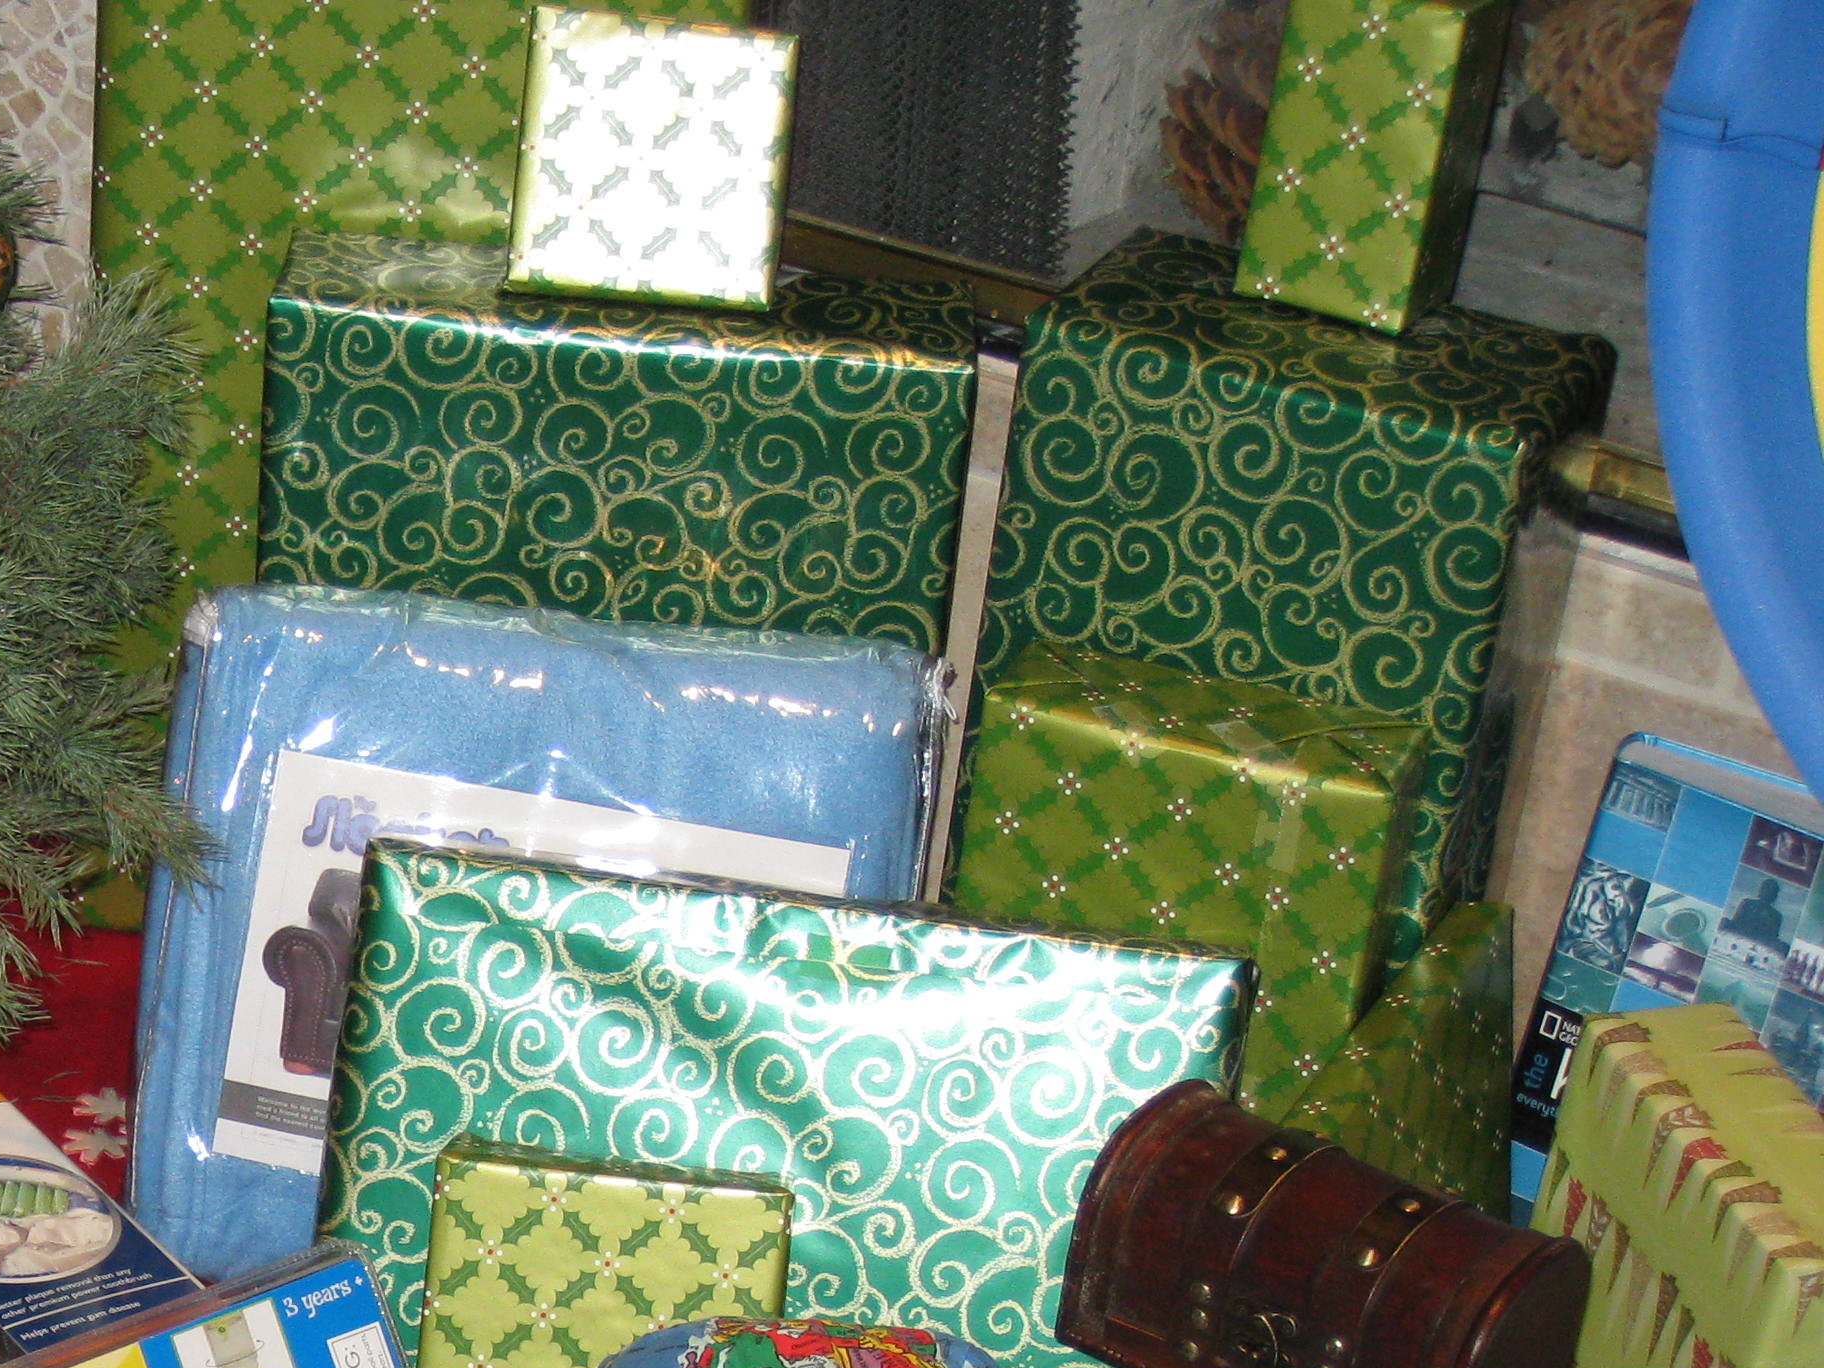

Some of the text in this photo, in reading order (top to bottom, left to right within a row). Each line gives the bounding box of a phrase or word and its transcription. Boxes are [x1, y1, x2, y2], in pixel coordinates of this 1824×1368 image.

[1524, 1054, 1548, 1088] the
[56, 1278, 92, 1292] removal
[282, 1297, 299, 1318] 3
[301, 1279, 352, 1319] years
[50, 1316, 85, 1332] prevent
[87, 1310, 106, 1322] gum
